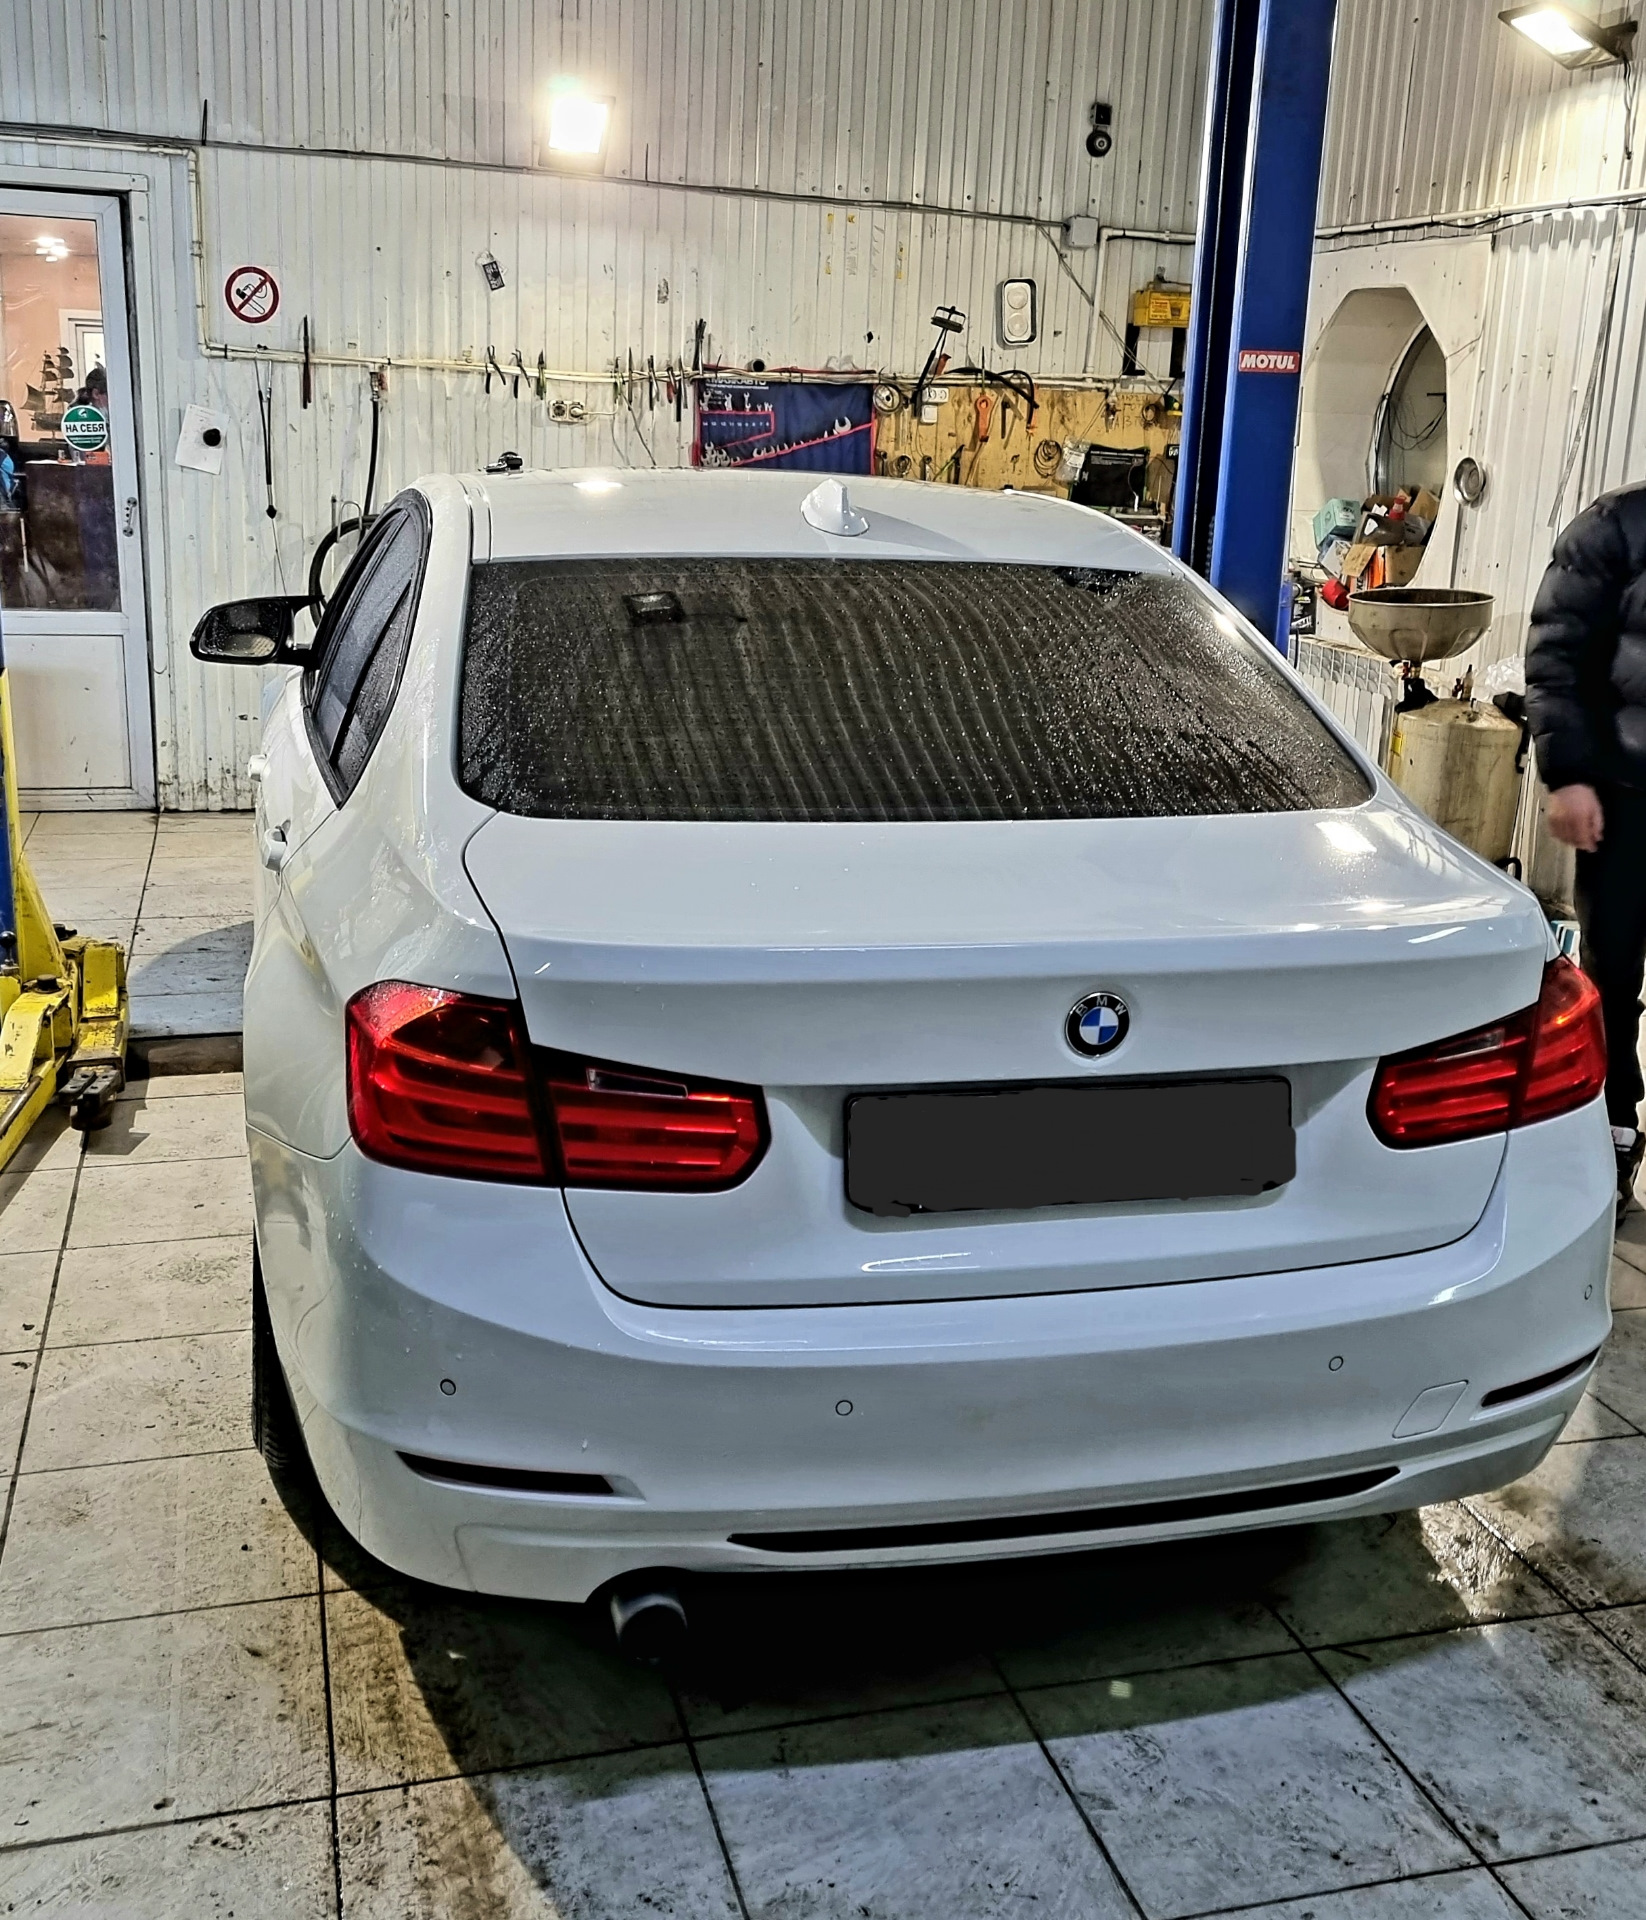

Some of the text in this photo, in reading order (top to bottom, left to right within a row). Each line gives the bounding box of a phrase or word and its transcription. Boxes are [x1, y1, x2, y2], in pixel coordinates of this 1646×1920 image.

[1241, 354, 1295, 370] MOTUL
[65, 423, 105, 433] НА СЕБЯ
[1075, 995, 1127, 1018] BMW
